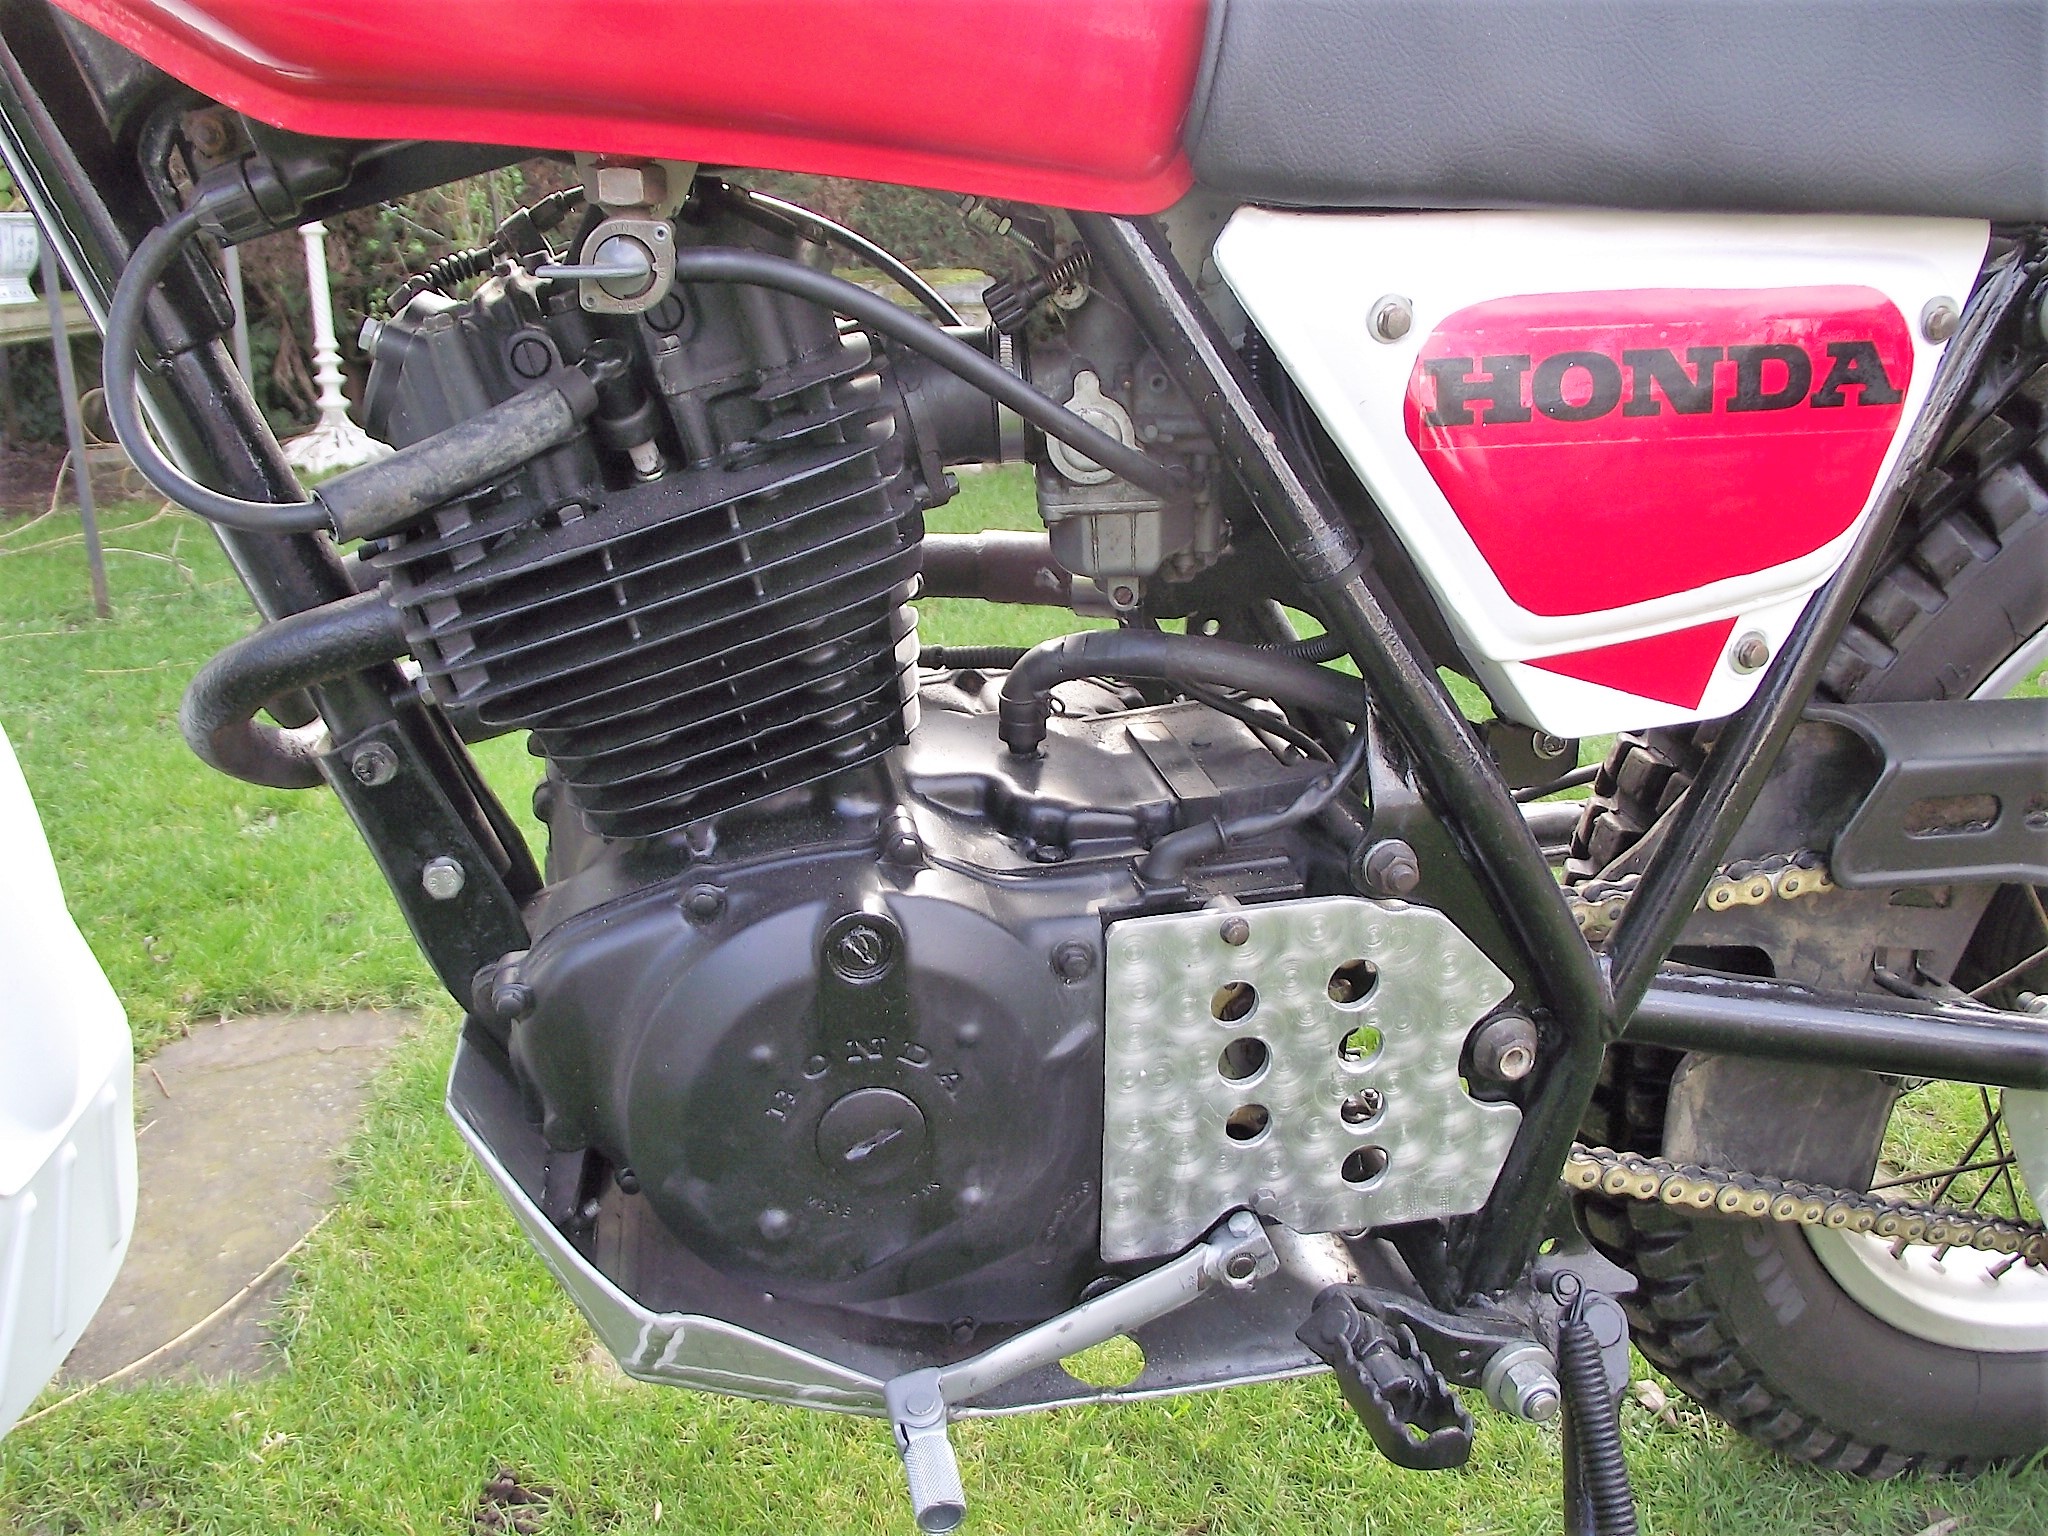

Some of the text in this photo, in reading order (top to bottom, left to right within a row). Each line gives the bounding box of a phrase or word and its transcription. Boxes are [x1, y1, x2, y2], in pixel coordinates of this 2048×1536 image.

[609, 223, 630, 233] ON
[1424, 341, 1905, 427] HONDA
[764, 1037, 962, 1122] HONDA
